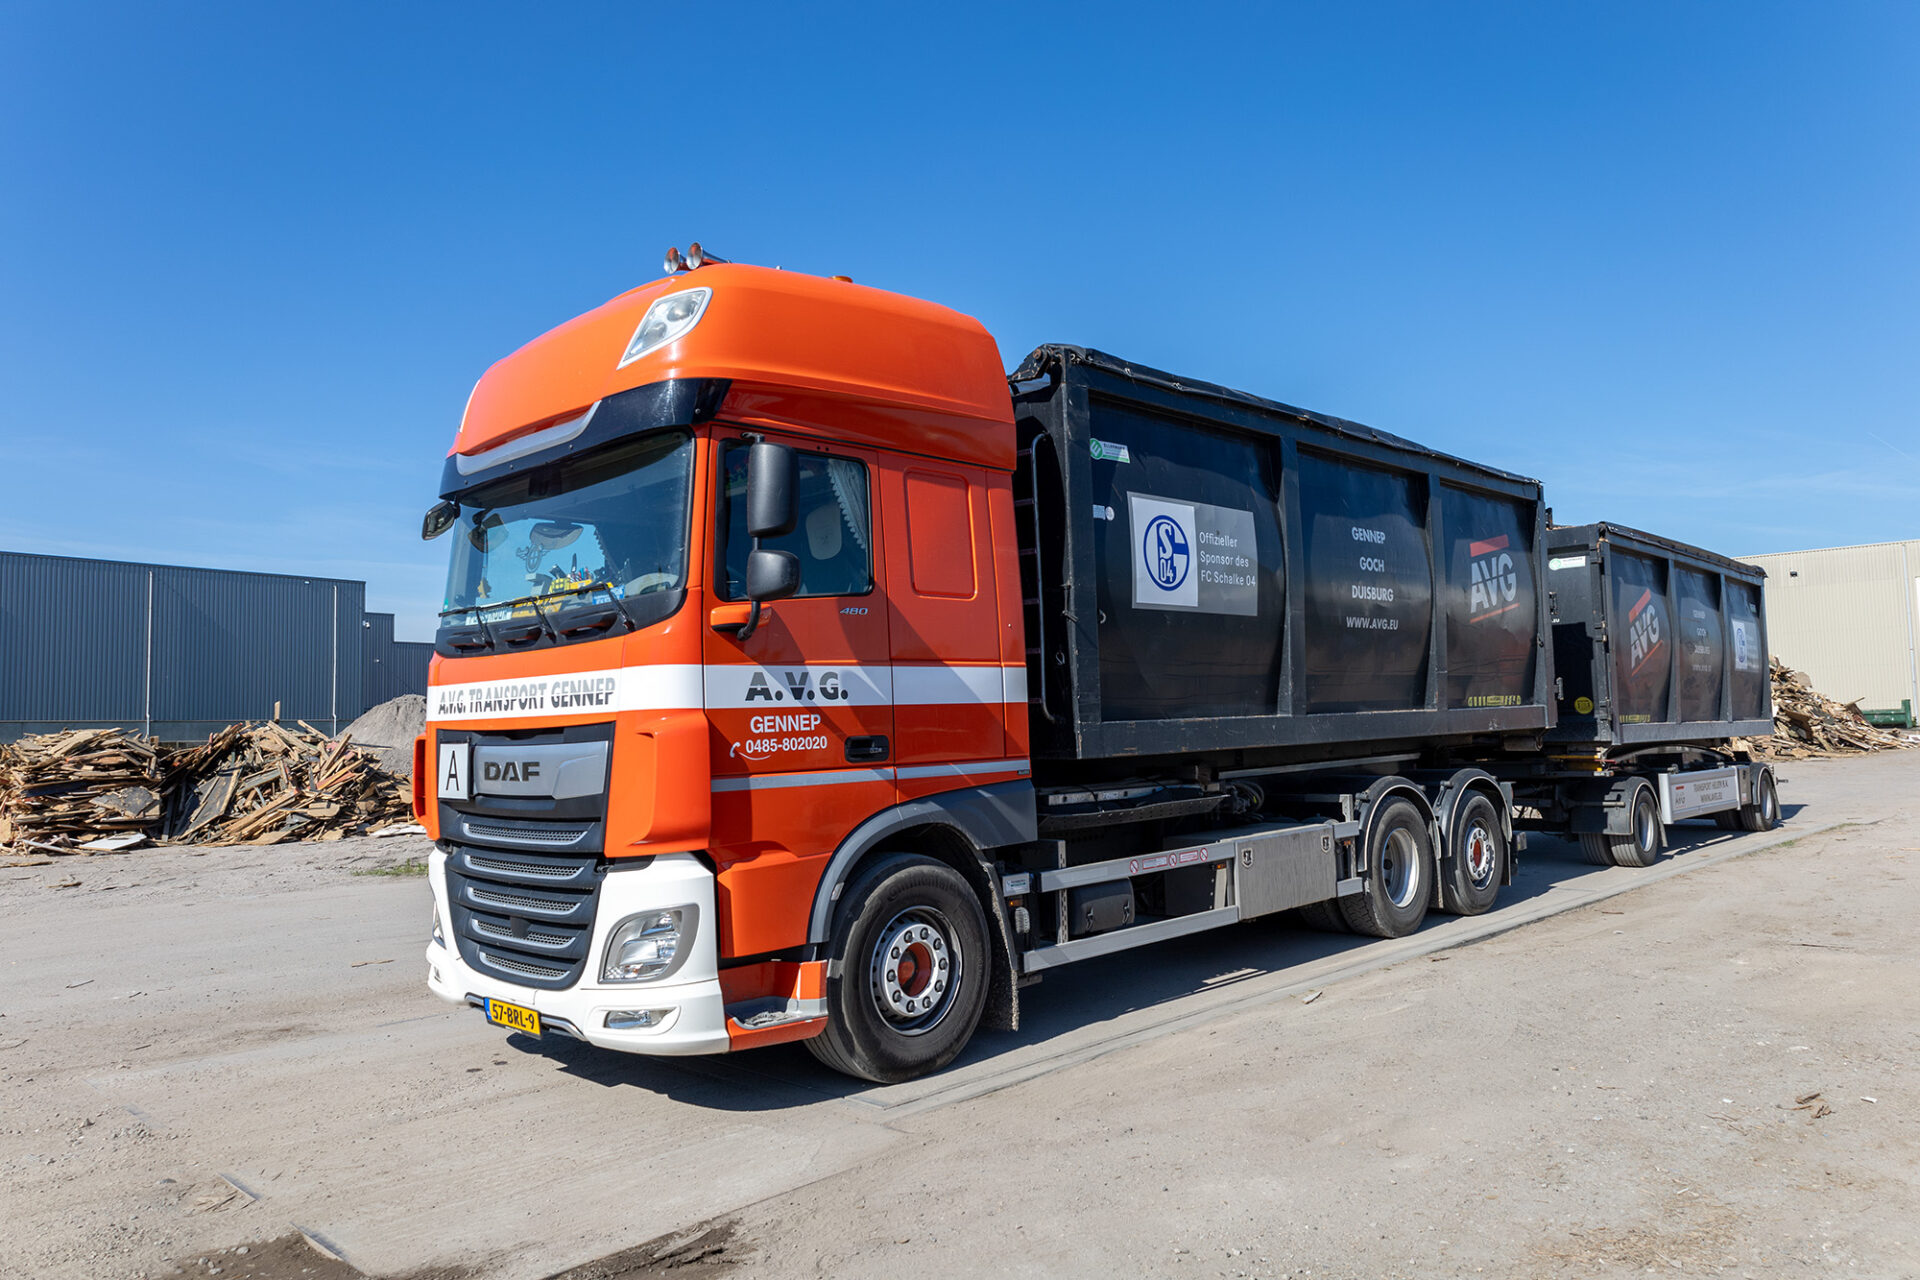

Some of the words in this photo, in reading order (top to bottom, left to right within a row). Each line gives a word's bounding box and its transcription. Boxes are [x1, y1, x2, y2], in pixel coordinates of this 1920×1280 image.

[1199, 531, 1238, 548] Offizieller
[1351, 526, 1386, 545] GENNEP
[1200, 551, 1234, 567] Sponsor
[1234, 555, 1249, 568] des
[1359, 556, 1385, 573] GOCH
[1201, 570, 1212, 584] FC
[1213, 570, 1244, 586] Schalke
[1245, 574, 1256, 587] 04
[1470, 552, 1517, 614] AVG
[1351, 584, 1394, 602] DUISBURG
[839, 607, 869, 616] 480
[1346, 616, 1399, 631] WWW.AVG.EU
[1629, 604, 1660, 669] AVG
[744, 671, 849, 701] A.V.G.
[438, 689, 467, 715] A.V.G.
[469, 682, 547, 713] TRANSPORT
[551, 677, 616, 709] GENNEP
[750, 714, 821, 734] GENNEP
[745, 736, 828, 754] 0485-802020
[445, 750, 460, 791] A
[484, 761, 540, 782] DAF
[492, 1002, 535, 1030] 57-BRL-9
